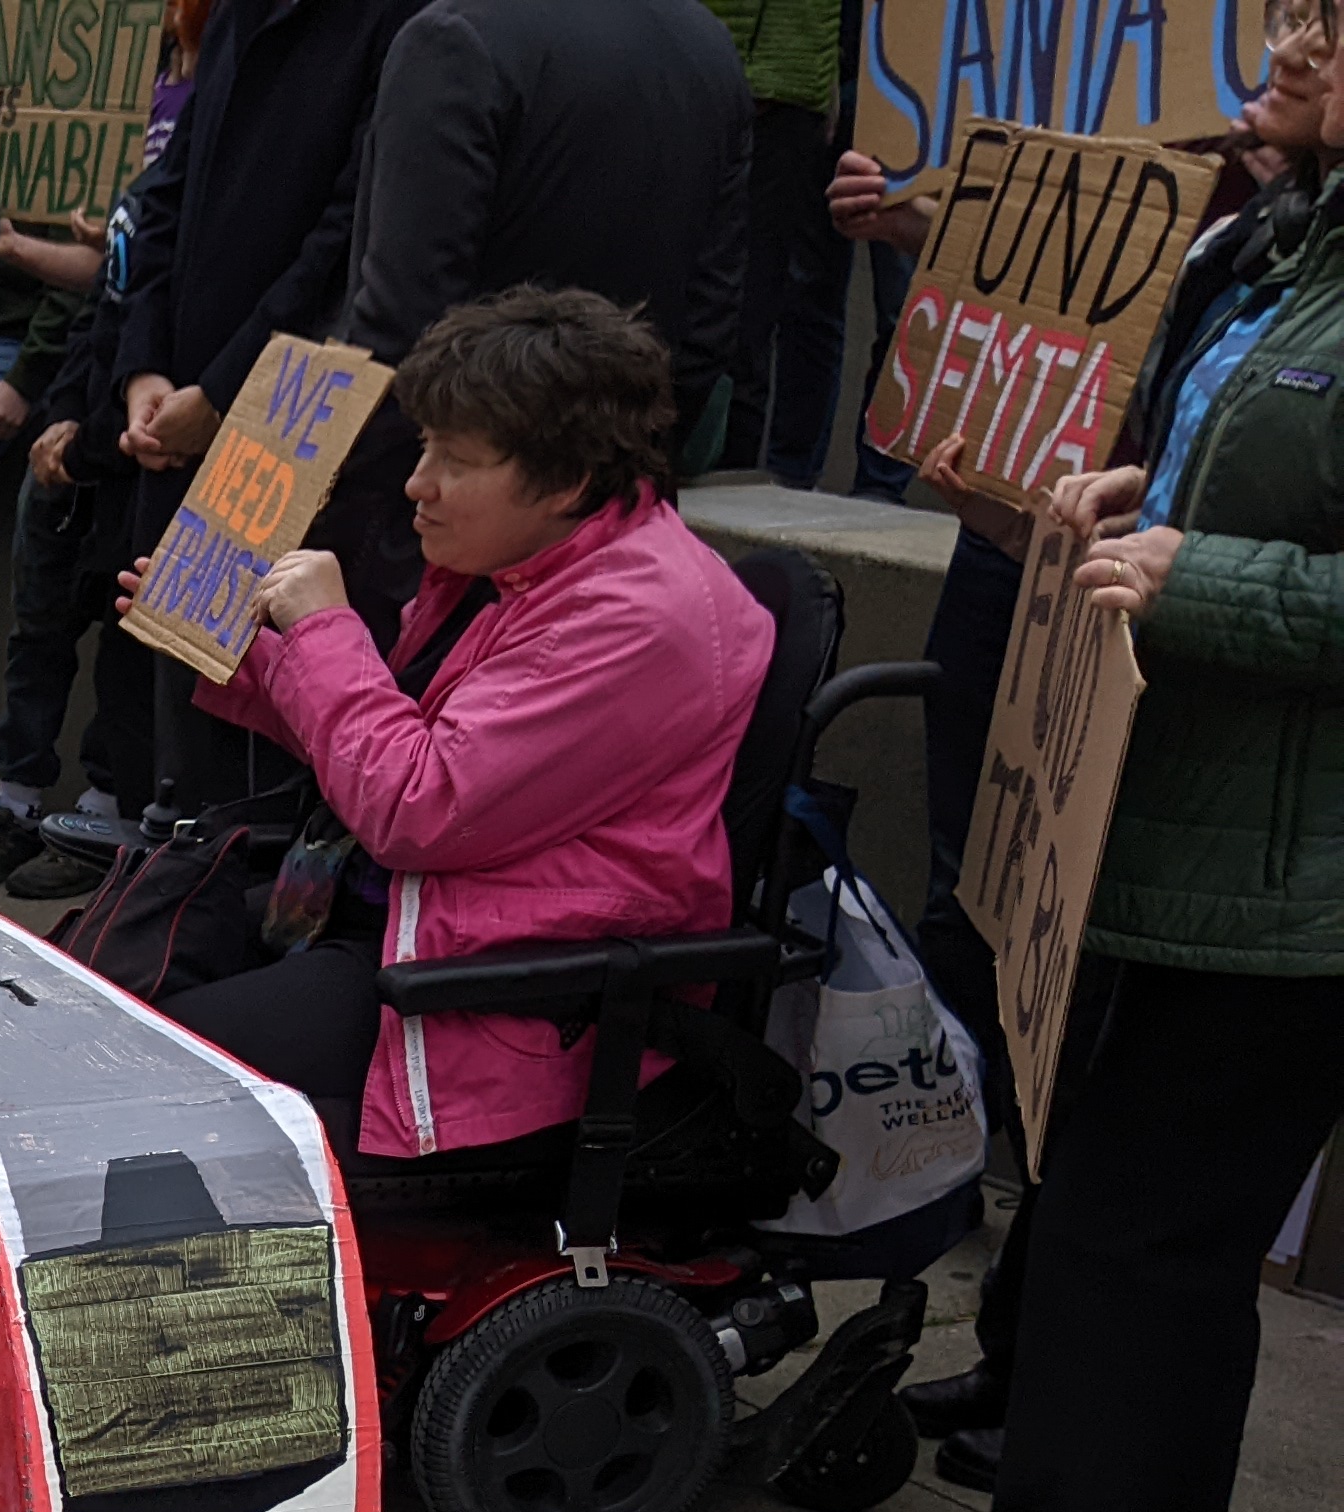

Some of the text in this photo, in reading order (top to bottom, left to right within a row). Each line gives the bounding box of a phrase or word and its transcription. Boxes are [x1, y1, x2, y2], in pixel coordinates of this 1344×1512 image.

[926, 128, 1180, 326] FUND
[266, 346, 354, 461] WE
[865, 285, 1114, 490] SFMTA
[198, 426, 295, 546] NEED
